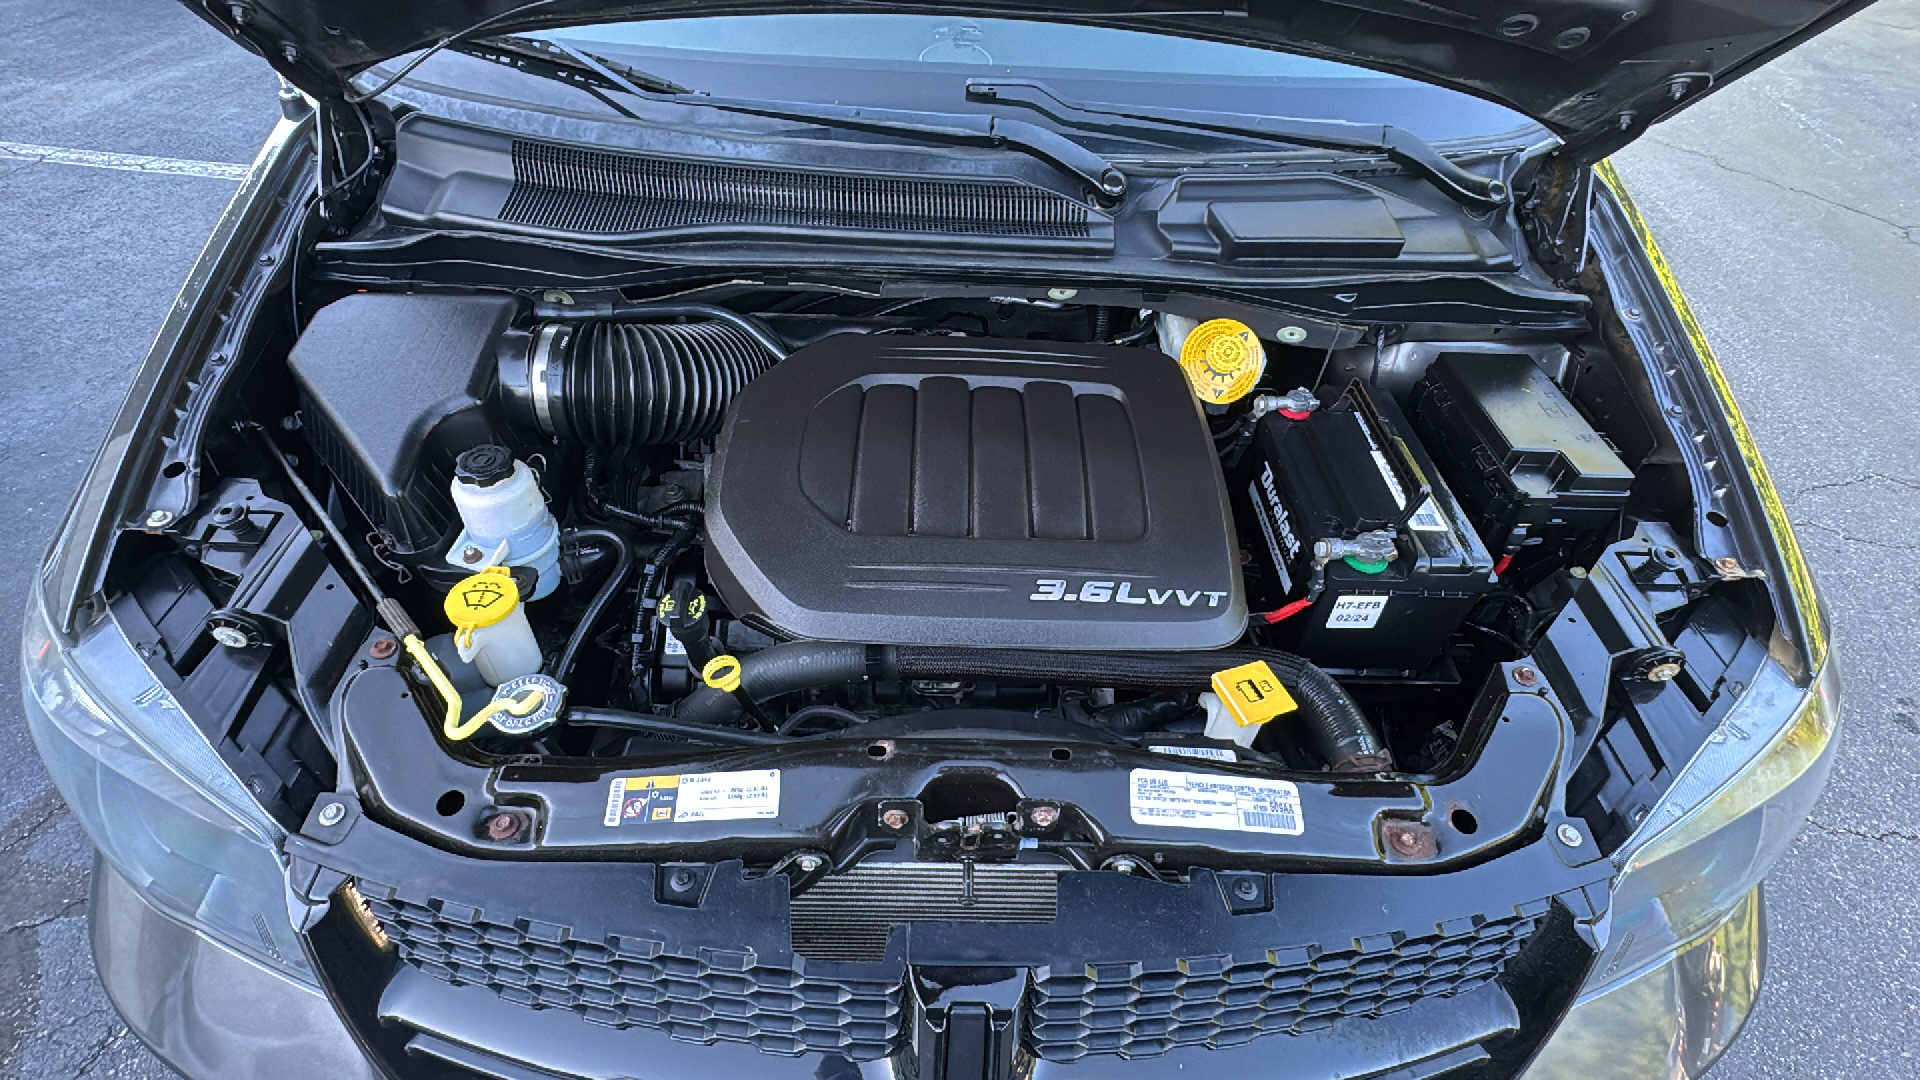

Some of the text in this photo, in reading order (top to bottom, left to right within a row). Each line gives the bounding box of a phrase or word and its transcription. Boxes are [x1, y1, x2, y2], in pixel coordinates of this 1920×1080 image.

[1261, 461, 1300, 560] Duralast
[1336, 601, 1381, 610] H7-EFB
[1336, 614, 1369, 622] 02/24
